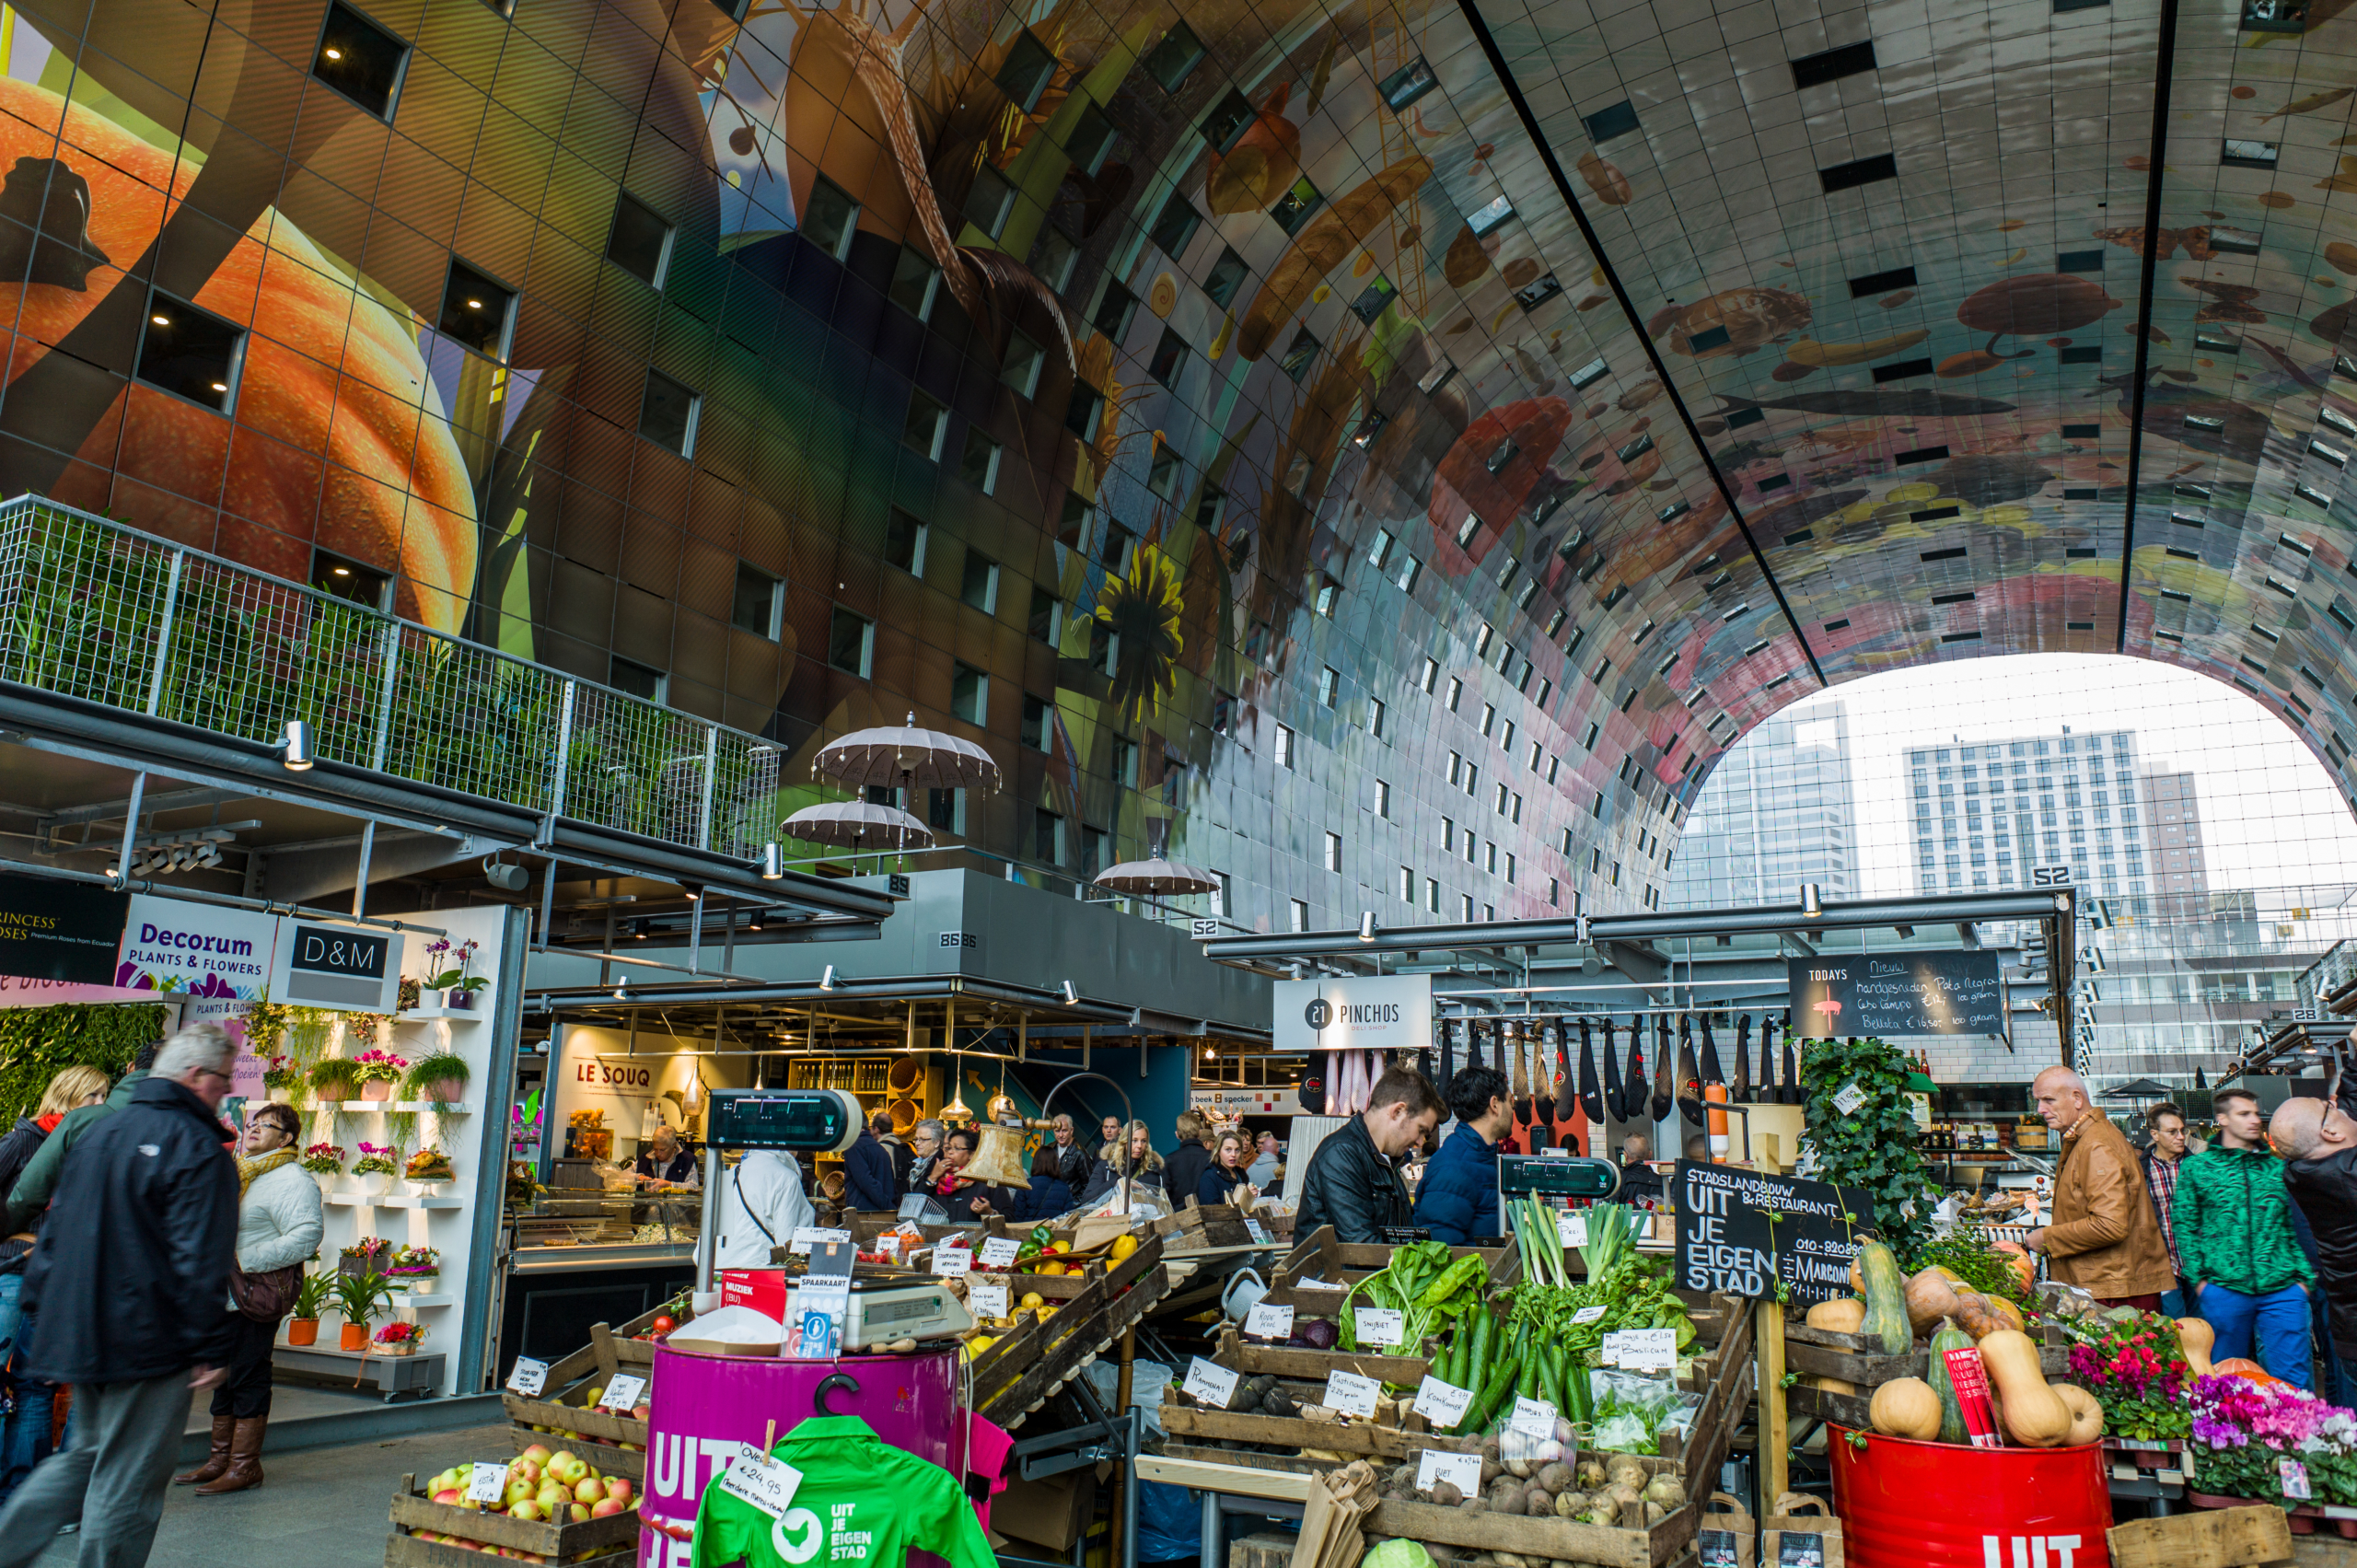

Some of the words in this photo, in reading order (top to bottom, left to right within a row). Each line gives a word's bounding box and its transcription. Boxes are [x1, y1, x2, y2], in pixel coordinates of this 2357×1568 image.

[890, 875, 910, 894] 89
[31, 932, 57, 940] Premium
[92, 939, 115, 947] Ecuador
[140, 923, 252, 956] Decorum
[305, 936, 374, 970] D&M
[129, 949, 181, 966] PLANTS
[187, 955, 198, 968] &
[203, 958, 261, 976] FLOWERS
[1870, 960, 1904, 973] Nieuw
[1808, 970, 1848, 981] TODAYS
[197, 1005, 222, 1014] PLANTS
[225, 1003, 230, 1012] &
[1312, 1005, 1325, 1023] 21
[1341, 1004, 1399, 1023] PINCHOS
[2294, 1010, 2316, 1019] 28
[577, 1064, 595, 1082] LE
[602, 1066, 650, 1087] SOUQ
[786, 1124, 807, 1133] EIGEN
[1687, 1168, 1794, 1197] STADSLANDBOUW
[1687, 1183, 1735, 1216] UIT
[1688, 1216, 1726, 1244] JE
[1688, 1244, 1777, 1274] EIGEN
[726, 1282, 753, 1295] MUZIEK
[802, 1278, 846, 1287] SPAARKAART
[1687, 1266, 1764, 1296] STAD
[1334, 1373, 1368, 1391] Pastinaak
[654, 1431, 741, 1501] UIT
[831, 1503, 855, 1517] UIT
[830, 1518, 846, 1532] JE
[831, 1531, 872, 1546] EIGEN
[830, 1546, 866, 1561] STAD
